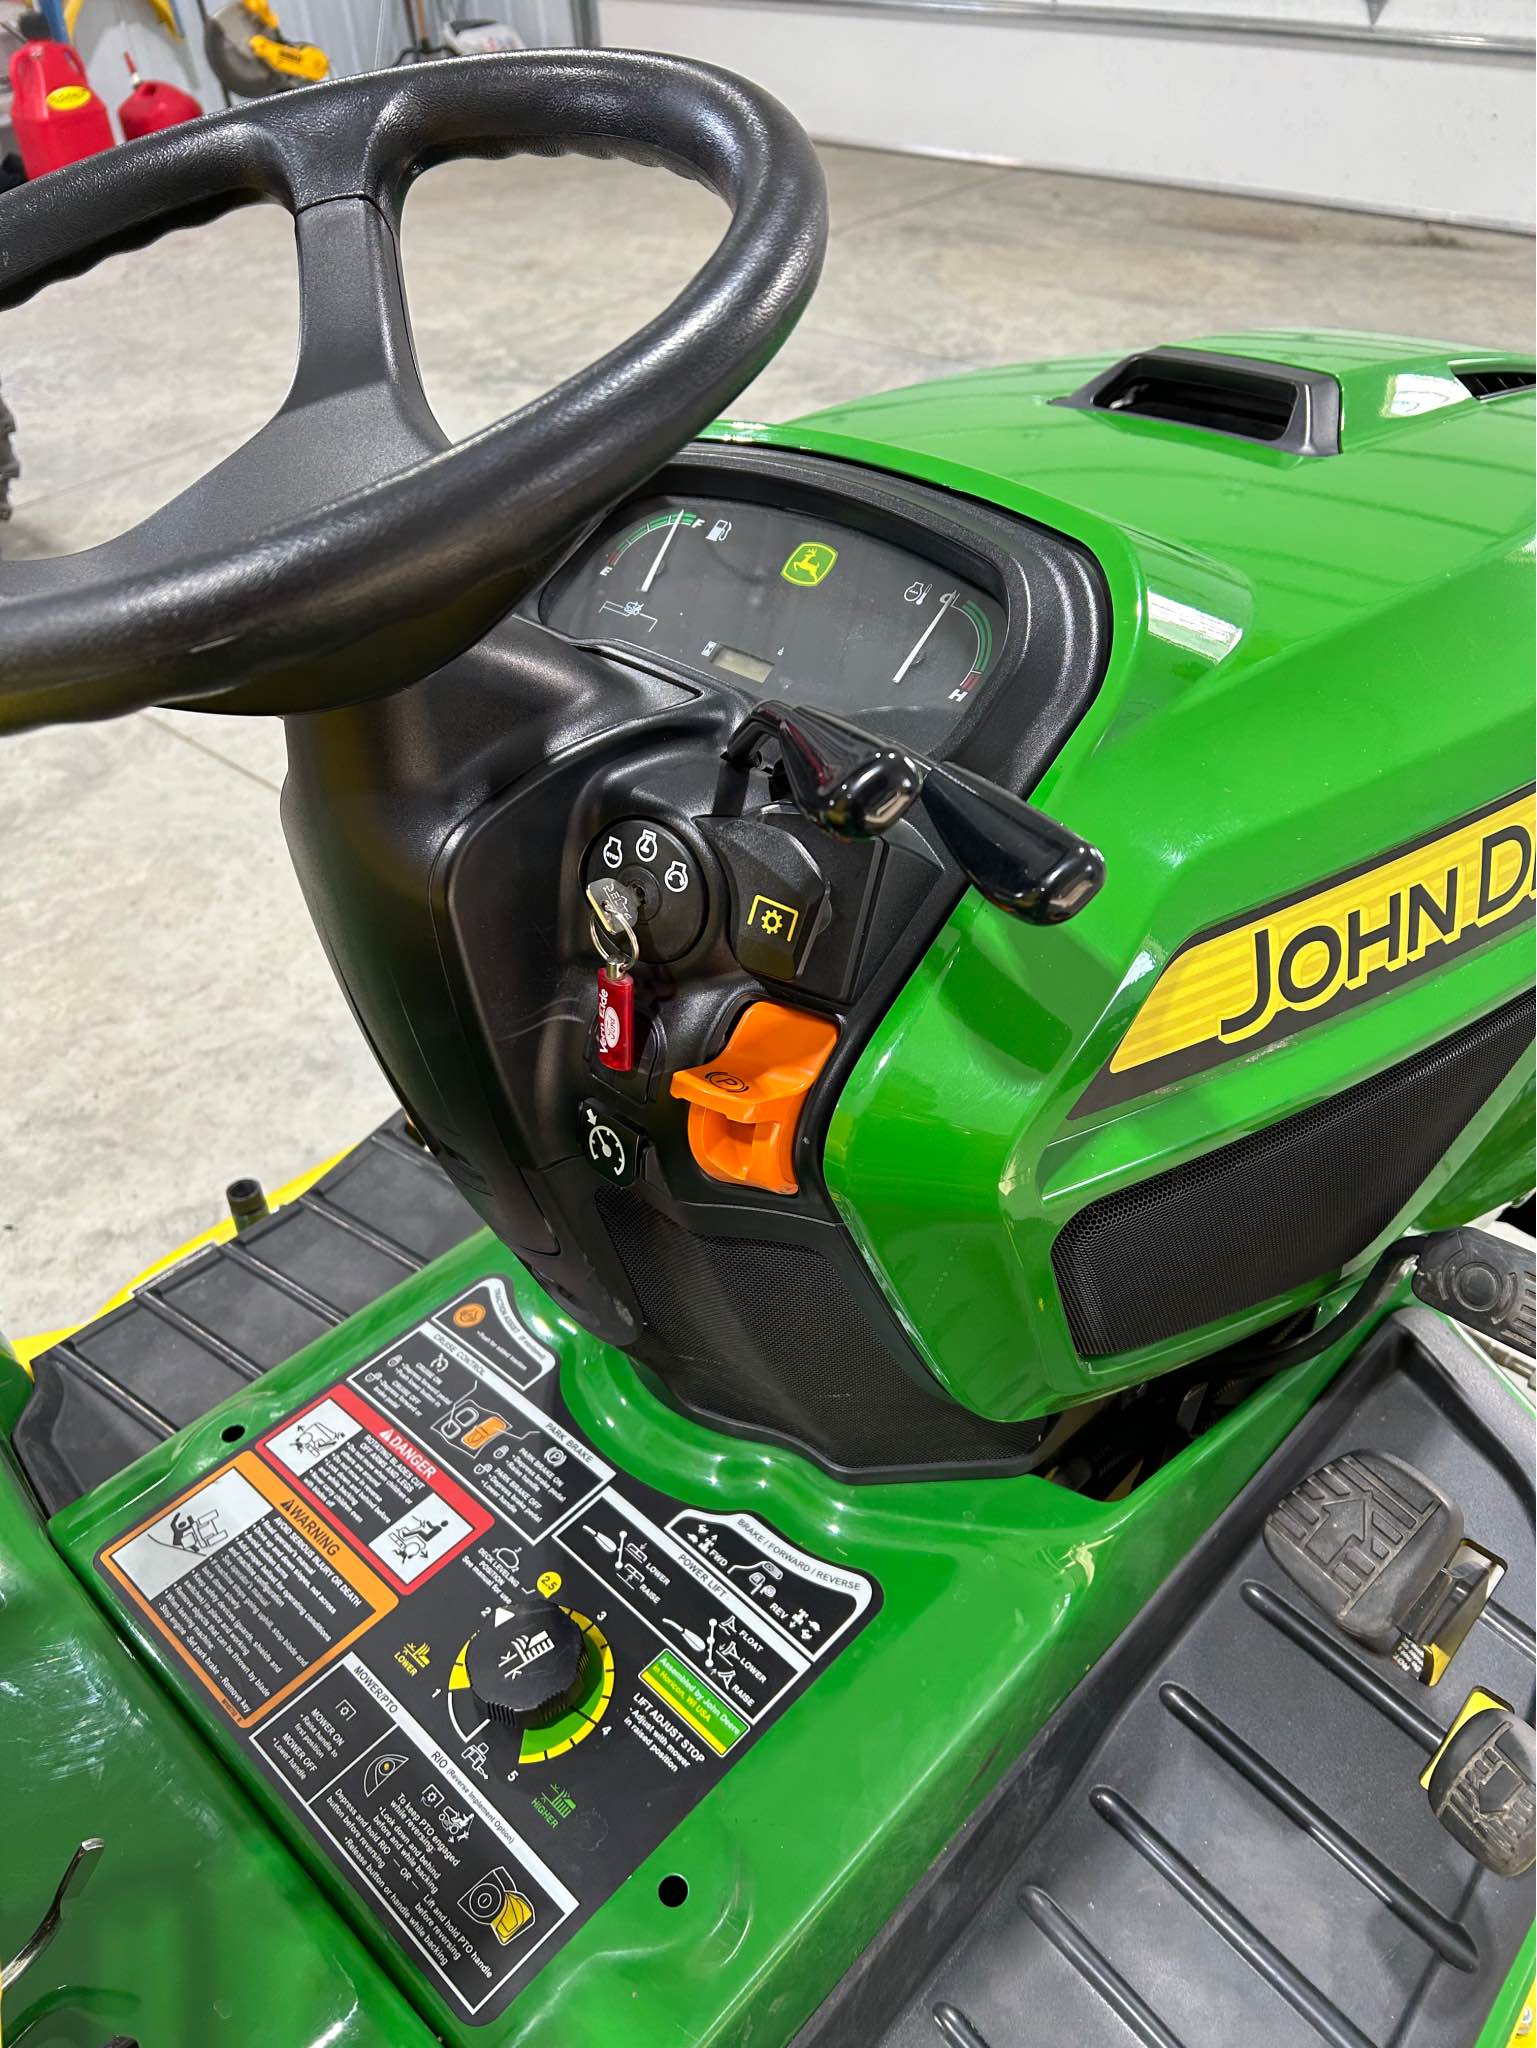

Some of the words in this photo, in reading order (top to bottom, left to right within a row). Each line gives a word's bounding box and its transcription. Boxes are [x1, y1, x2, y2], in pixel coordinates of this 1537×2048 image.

[691, 518, 706, 528] F
[599, 566, 613, 577] E
[948, 688, 968, 702] H
[1219, 866, 1459, 1036] JOHN
[433, 1334, 456, 1352] CRUISE
[456, 1351, 484, 1375] CONTROL
[389, 1435, 436, 1478] DANGER
[545, 1422, 566, 1440] PARK
[566, 1439, 592, 1462] BRAKE
[494, 1467, 511, 1482] PARK
[509, 1480, 530, 1499] BRAKE
[528, 1497, 541, 1508] OFF
[519, 1448, 535, 1462] PARK
[533, 1460, 554, 1478] BRAKE
[553, 1477, 563, 1486] ON
[289, 1505, 339, 1556] WARNING
[478, 1547, 497, 1565] DECK
[494, 1563, 519, 1586] LEVELING
[479, 1560, 504, 1585] POSITION
[645, 1562, 669, 1585] LOWER
[709, 1549, 727, 1565] FWD
[737, 1518, 764, 1542] BRAKE
[767, 1542, 810, 1571] FORWARD
[816, 1570, 860, 1590] REVERSE
[462, 1555, 473, 1567] See
[472, 1566, 492, 1584] manual
[489, 1582, 500, 1592] for
[499, 1590, 511, 1604] use
[541, 1575, 557, 1590] 2.5
[639, 1584, 660, 1603] RAISE
[678, 1554, 708, 1581] POWER
[707, 1580, 726, 1596] LIFT
[481, 1607, 490, 1616] 2
[597, 1611, 606, 1620] 3
[769, 1602, 788, 1618] REV
[159, 1604, 171, 1618] Stop
[169, 1616, 186, 1635] engine
[193, 1645, 206, 1659] park
[204, 1657, 219, 1674] brake
[221, 1676, 241, 1701] Remove
[240, 1699, 250, 1712] key
[174, 1585, 193, 1607] Remove
[191, 1606, 209, 1626] objects
[207, 1624, 219, 1636] that
[216, 1635, 227, 1646] can
[225, 1644, 233, 1654] be
[231, 1652, 249, 1673] thrown
[248, 1671, 256, 1681] by
[254, 1678, 269, 1696] blade
[739, 1630, 763, 1651] FLOAT
[394, 1651, 417, 1676] LOWER
[740, 1657, 766, 1683] LOWER
[353, 1665, 397, 1712] MOWER/PTO
[652, 1664, 660, 1672] in
[659, 1670, 684, 1698] Horicon,
[686, 1696, 696, 1706] WI
[695, 1705, 710, 1721] USA
[659, 1657, 696, 1691] Assembled
[693, 1689, 703, 1700] by
[702, 1698, 720, 1716] John
[719, 1713, 739, 1734] Deere
[731, 1684, 754, 1706] RAISE
[294, 1723, 306, 1736] first
[302, 1735, 323, 1758] position
[302, 1715, 316, 1732] Raise
[315, 1730, 332, 1750] handle
[330, 1749, 337, 1757] to
[311, 1708, 335, 1735] MOWER
[332, 1733, 344, 1745] ON
[602, 1726, 611, 1735] 4
[624, 1716, 631, 1726] in
[631, 1724, 653, 1745] raised
[649, 1744, 677, 1771] position
[631, 1710, 654, 1732] Adjust
[653, 1730, 667, 1745] with
[666, 1744, 690, 1766] mower
[633, 1692, 653, 1711] LIFT
[649, 1710, 683, 1741] ADJUST
[680, 1739, 704, 1761] STOP
[273, 1740, 290, 1759] Lower
[288, 1758, 305, 1779] handle
[282, 1732, 305, 1759] MOWER
[303, 1758, 317, 1770] OFF
[507, 1770, 518, 1781] 5
[431, 1751, 447, 1767] RIO
[446, 1768, 468, 1792] (Reverse
[468, 1791, 495, 1822] Implement
[494, 1820, 514, 1843] Option)
[531, 1798, 558, 1828] HIGHER
[326, 1795, 344, 1817] button
[342, 1815, 360, 1837] before
[359, 1836, 385, 1868] reversing
[335, 1788, 356, 1815] Depress
[355, 1814, 368, 1827] and
[365, 1825, 380, 1842] hold
[377, 1839, 390, 1854] RIO
[390, 1799, 406, 1819] while
[405, 1818, 435, 1853] reversing:
[397, 1792, 405, 1804] To
[402, 1801, 420, 1820] keep
[418, 1818, 434, 1835] PTO
[432, 1835, 460, 1866] engaged
[373, 1815, 390, 1837] before
[389, 1836, 403, 1849] and
[400, 1848, 415, 1866] while
[415, 1864, 437, 1894] backing
[380, 1808, 394, 1826] Look
[394, 1825, 409, 1844] down
[408, 1843, 421, 1857] and
[419, 1854, 440, 1879] behind
[400, 1867, 411, 1880] OR
[345, 1838, 366, 1865] Release
[365, 1863, 384, 1887] button
[384, 1886, 391, 1894] or
[390, 1893, 409, 1918] handle
[409, 1916, 424, 1936] while
[423, 1934, 447, 1965] backing
[414, 1902, 433, 1926] before
[432, 1925, 460, 1960] reversing
[423, 1894, 435, 1908] Lift
[433, 1907, 446, 1921] and
[444, 1919, 460, 1938] hold
[457, 1935, 472, 1953] PTO
[471, 1951, 491, 1977] handle
